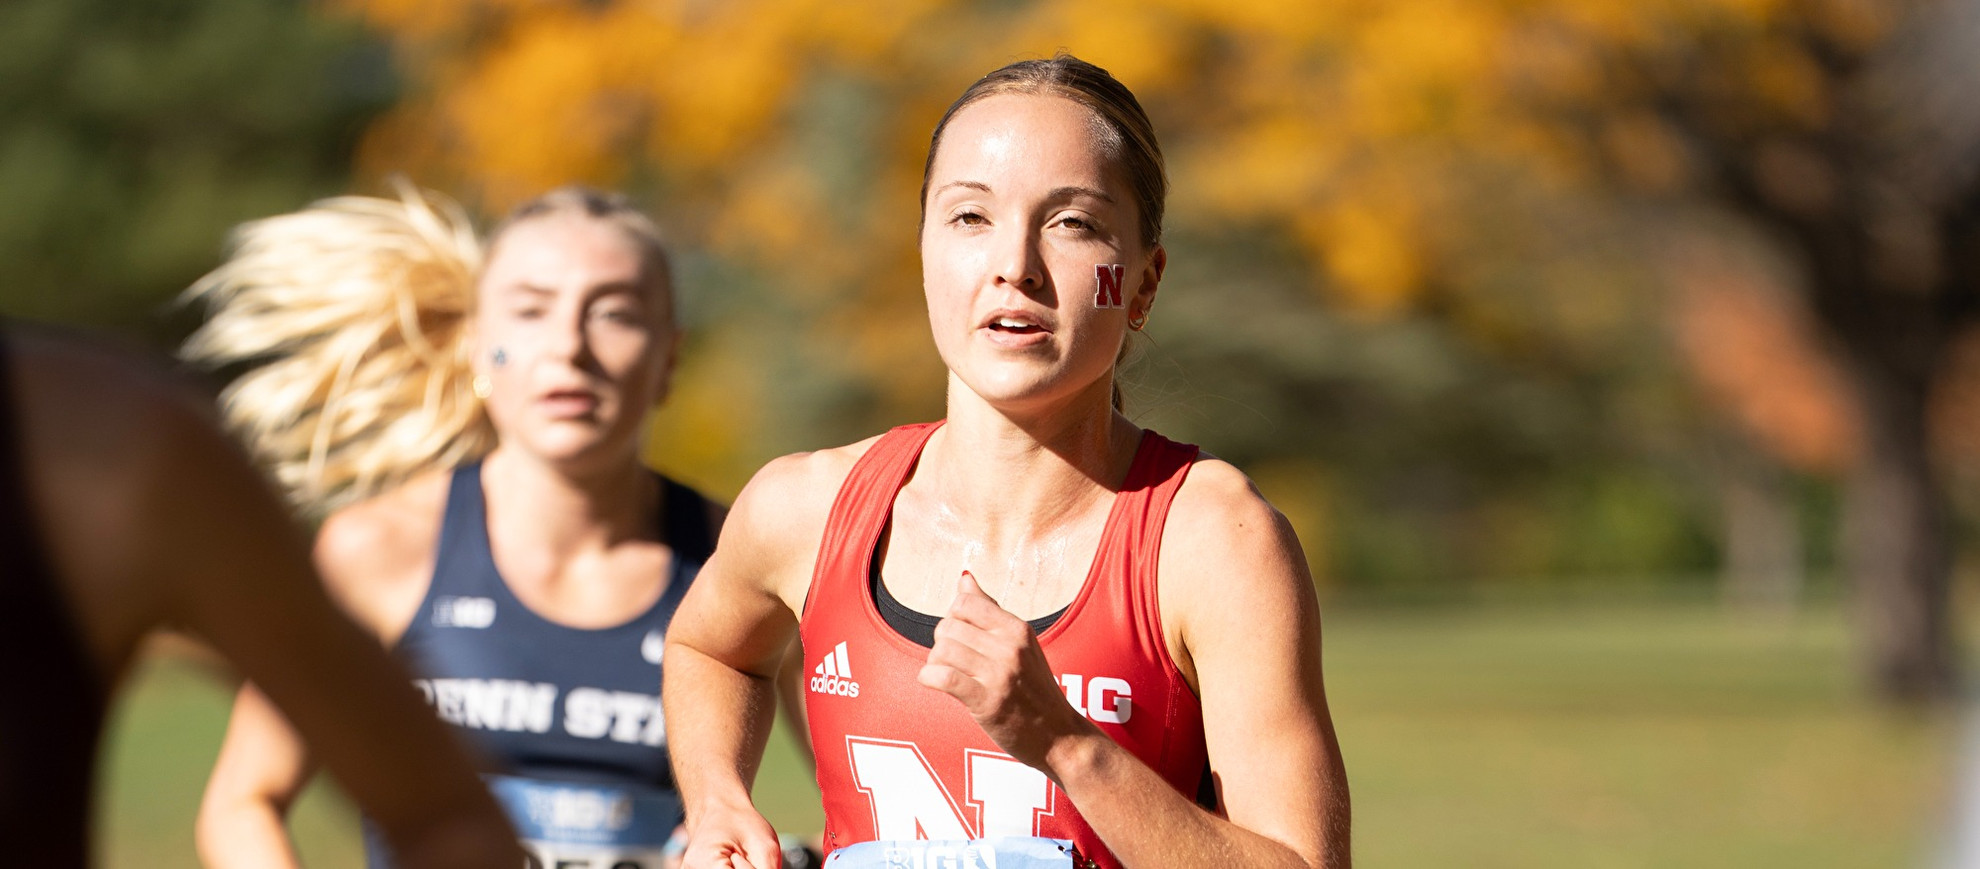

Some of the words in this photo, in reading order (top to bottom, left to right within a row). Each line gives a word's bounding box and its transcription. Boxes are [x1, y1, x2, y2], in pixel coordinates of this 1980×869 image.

[1094, 263, 1125, 309] N
[410, 679, 558, 733] ENN
[811, 673, 860, 698] adidas
[845, 735, 1056, 841] N
